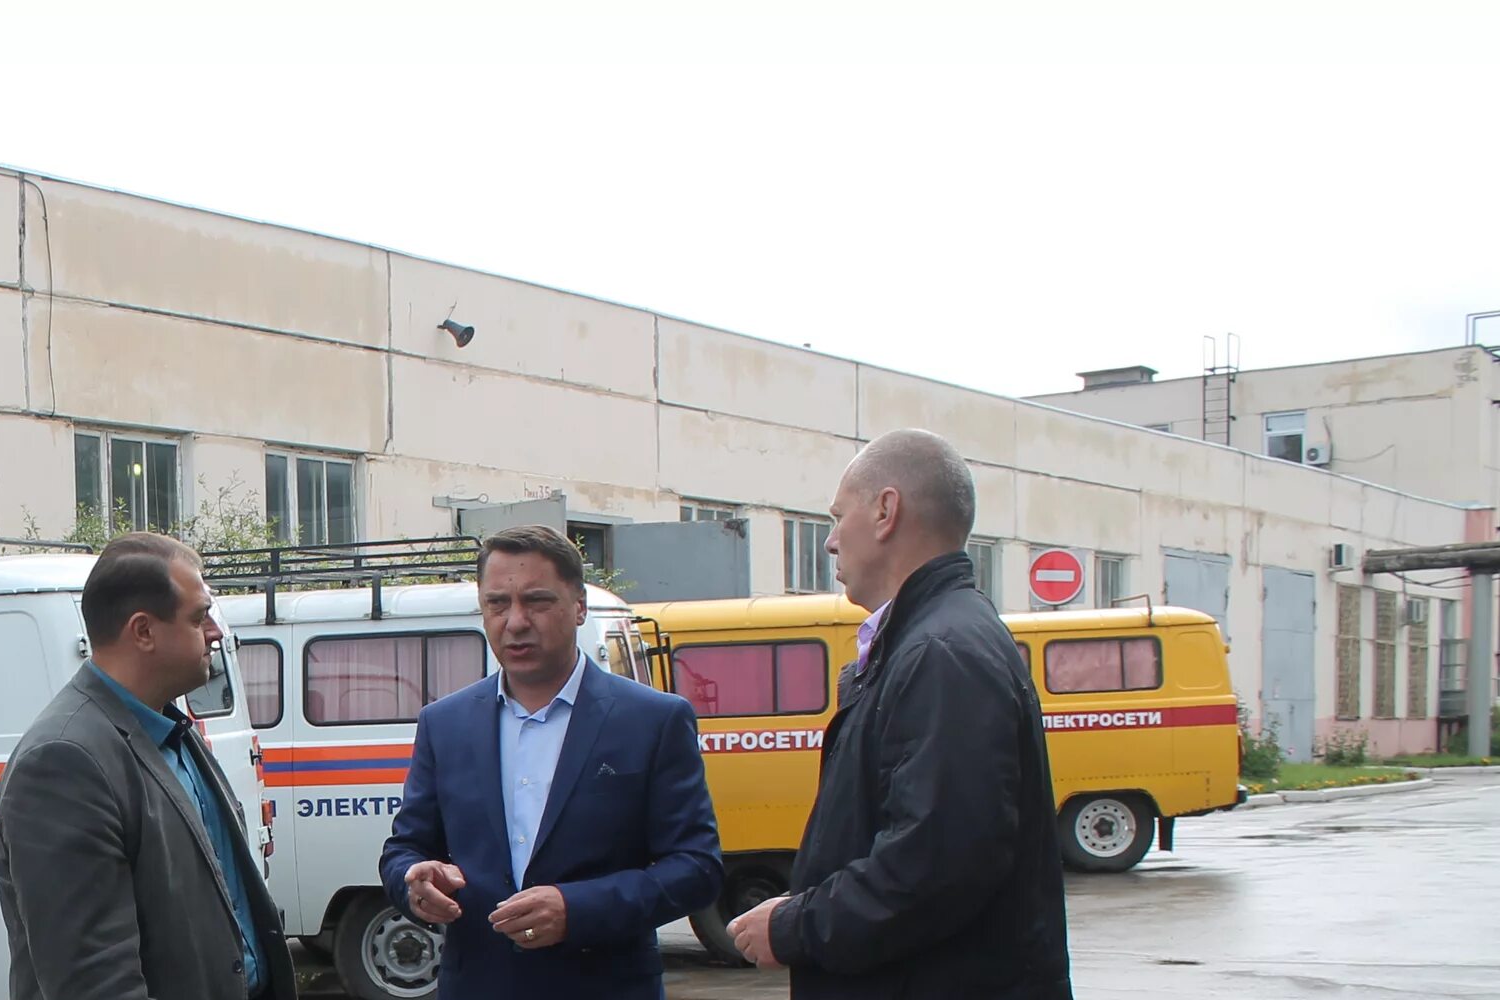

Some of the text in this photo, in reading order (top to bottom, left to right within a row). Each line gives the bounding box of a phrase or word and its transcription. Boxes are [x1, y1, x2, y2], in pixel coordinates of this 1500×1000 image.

[1041, 711, 1162, 729] ЛЕКТРОСЕТИ
[697, 730, 824, 751] КТРОСЕТИ
[297, 796, 403, 818] ЭЛЕКТР
